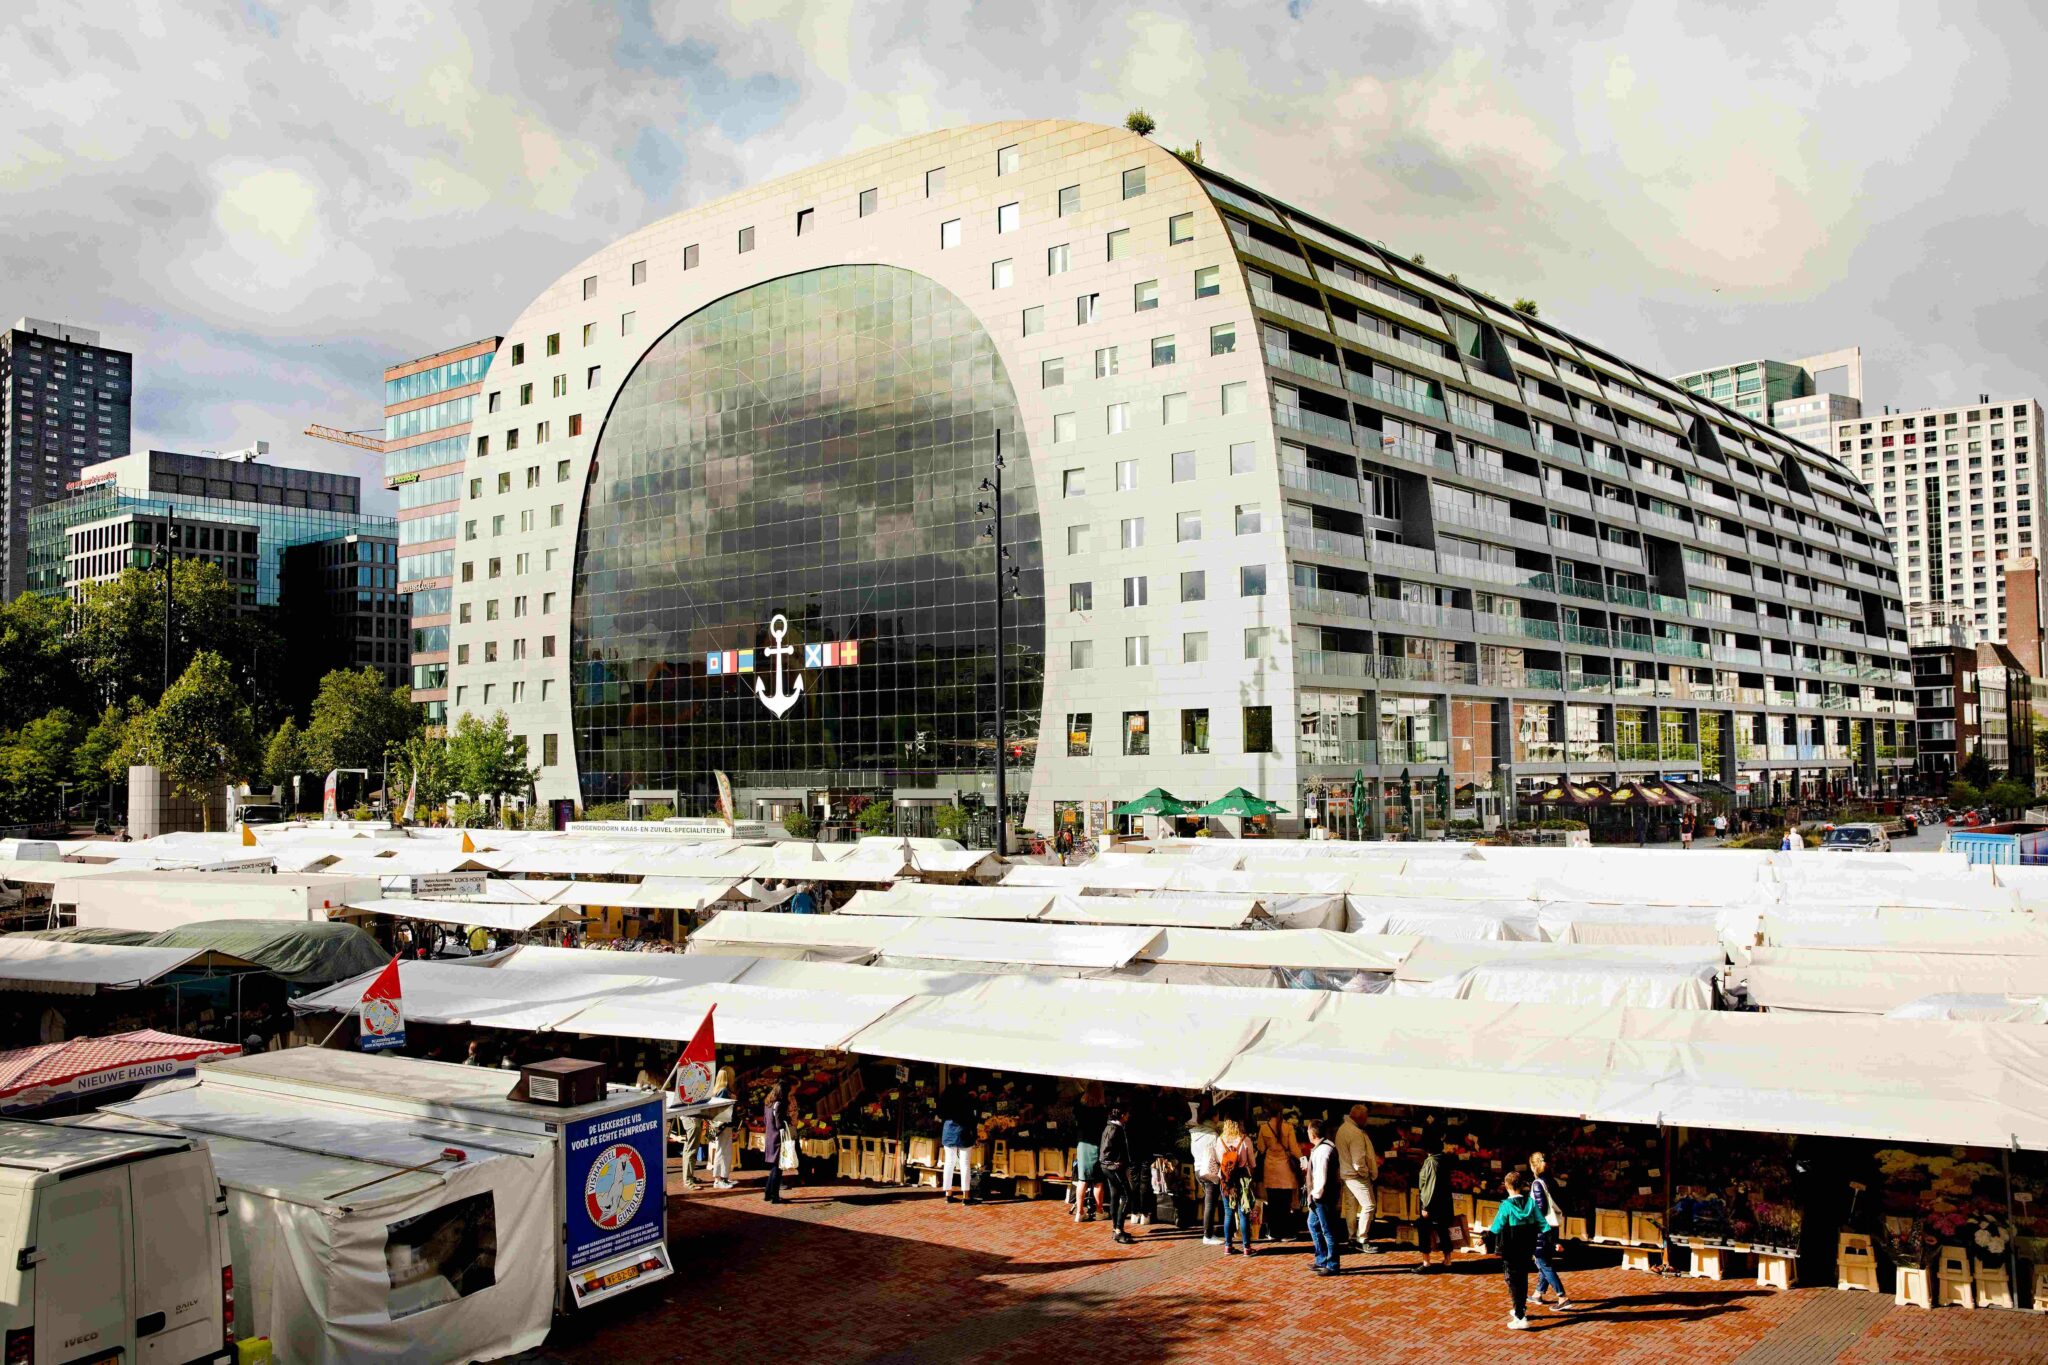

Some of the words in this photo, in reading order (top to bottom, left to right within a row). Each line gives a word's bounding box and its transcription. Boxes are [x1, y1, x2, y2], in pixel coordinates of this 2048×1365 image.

[571, 824, 619, 832] HOOGENDOORN
[650, 826, 726, 834] ZUIVEL-SPECIALITEITEN
[77, 1070, 125, 1090] NIEUWE
[128, 1062, 174, 1078] HARING
[571, 1138, 589, 1151] VOOR
[590, 1135, 598, 1146] DE
[598, 1130, 618, 1144] ECHTE
[618, 1120, 658, 1138] FIJNPROEVER
[588, 1124, 597, 1135] DE
[597, 1115, 631, 1133] LEKKERSTE
[631, 1113, 642, 1123] VIS
[588, 1151, 616, 1192] VISHANDEL
[617, 1180, 643, 1223] GUNDLACH
[175, 1299, 199, 1311] DAILY
[64, 1331, 99, 1348] IVECO
